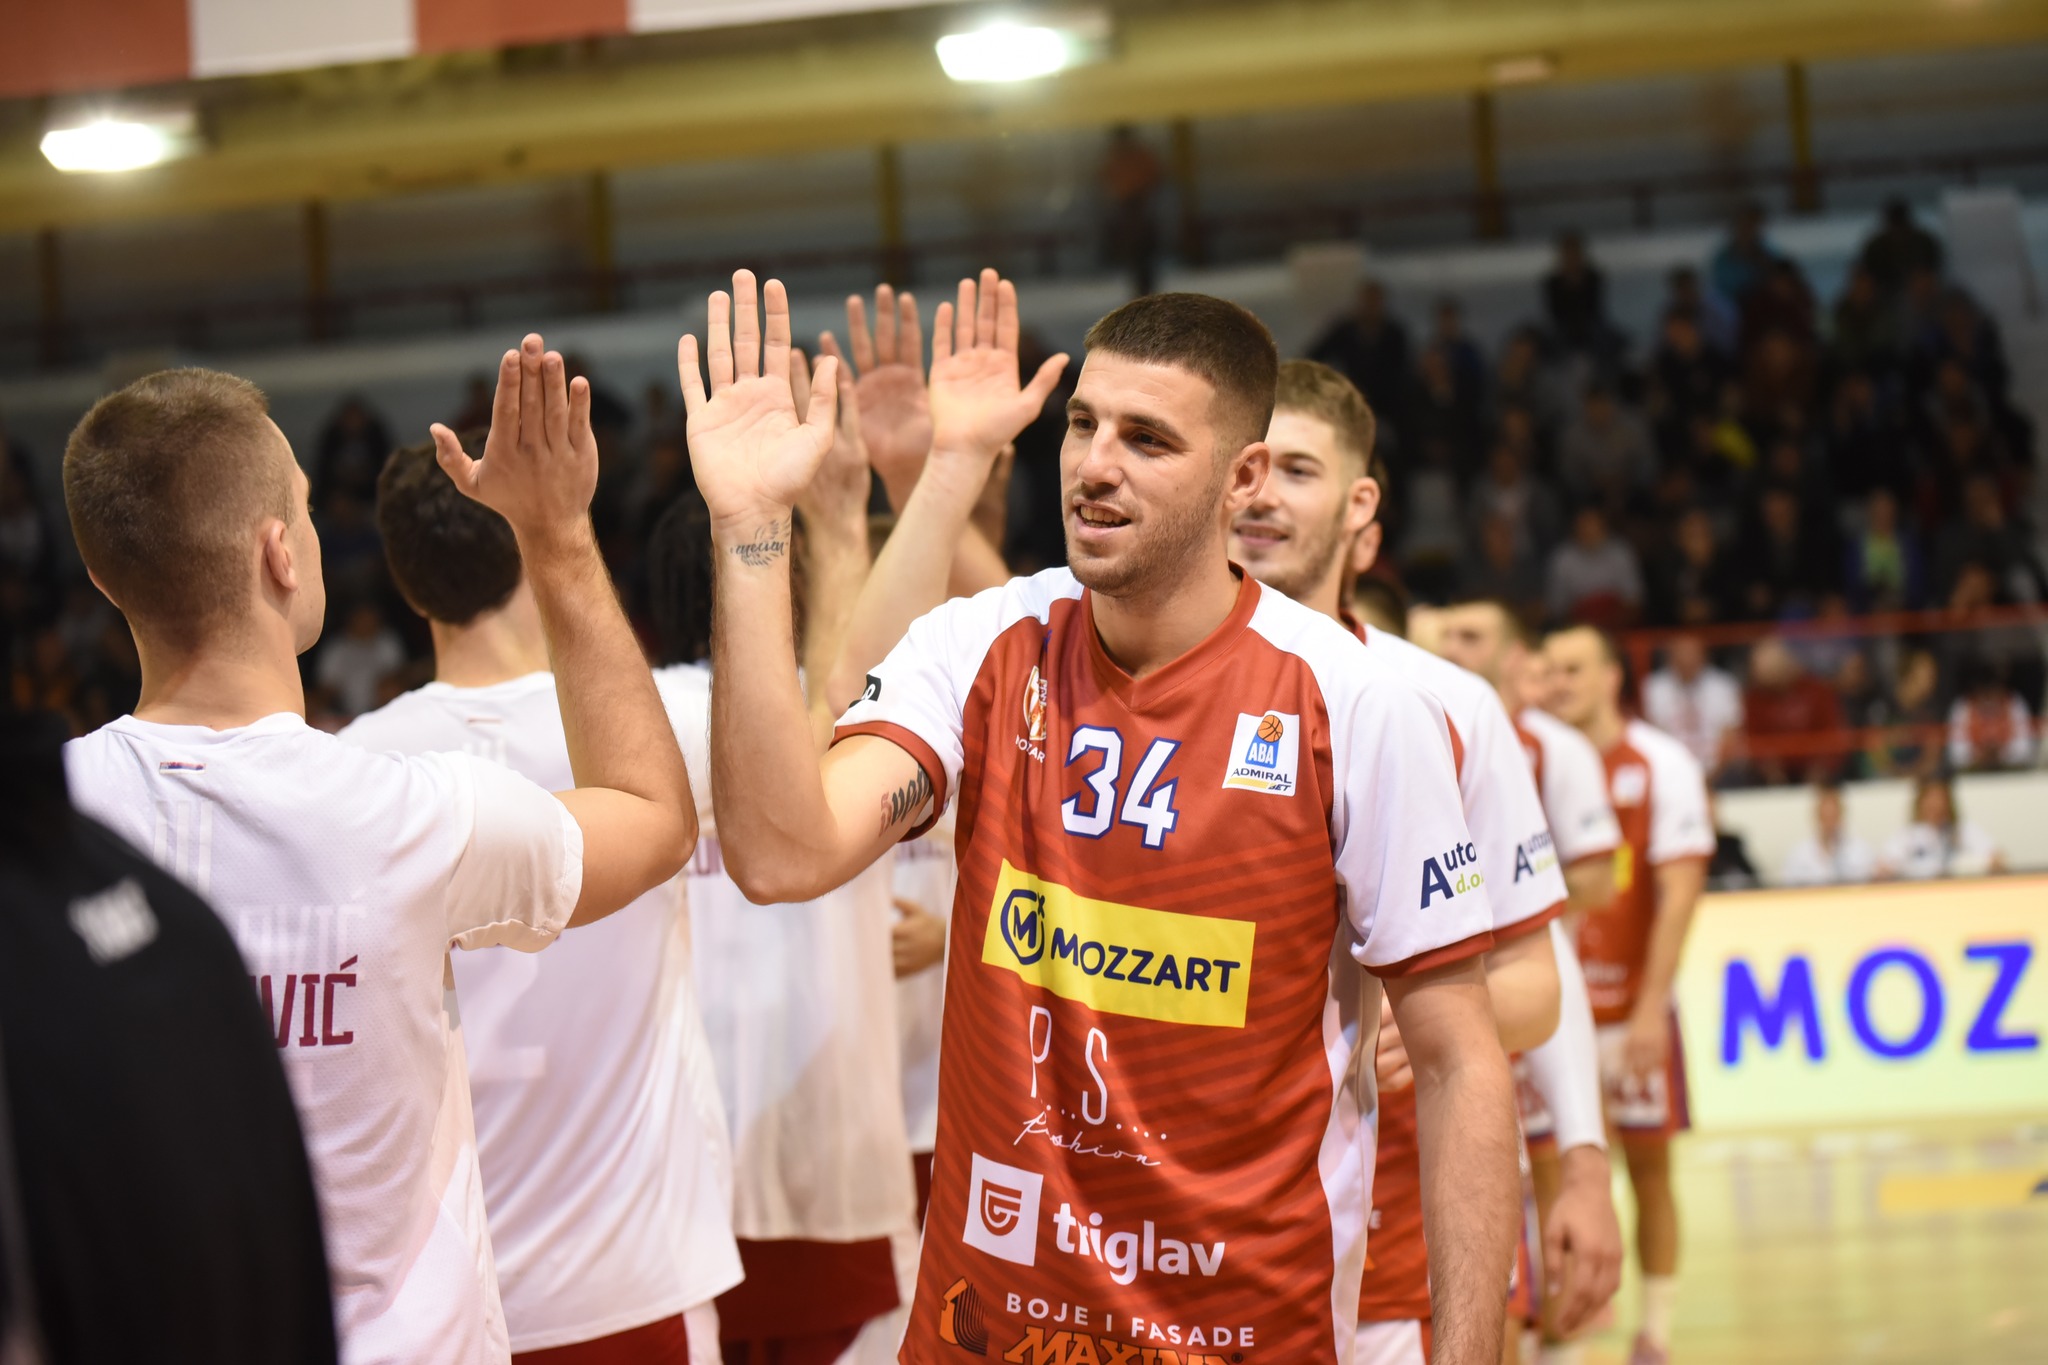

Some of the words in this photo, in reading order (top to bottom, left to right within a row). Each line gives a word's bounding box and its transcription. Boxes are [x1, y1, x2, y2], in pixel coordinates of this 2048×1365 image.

[1062, 724, 1181, 851] 34
[1231, 767, 1292, 784] ADMIRAL
[1247, 742, 1275, 765] ABA
[1050, 927, 1241, 994] MOZZART
[249, 954, 359, 1048] VIĆ
[1721, 942, 2040, 1066] MOZ
[1052, 1202, 1226, 1286] triglav
[1006, 1292, 1089, 1326] BOJE
[1105, 1313, 1113, 1333] I
[1131, 1317, 1255, 1347] FASADE
